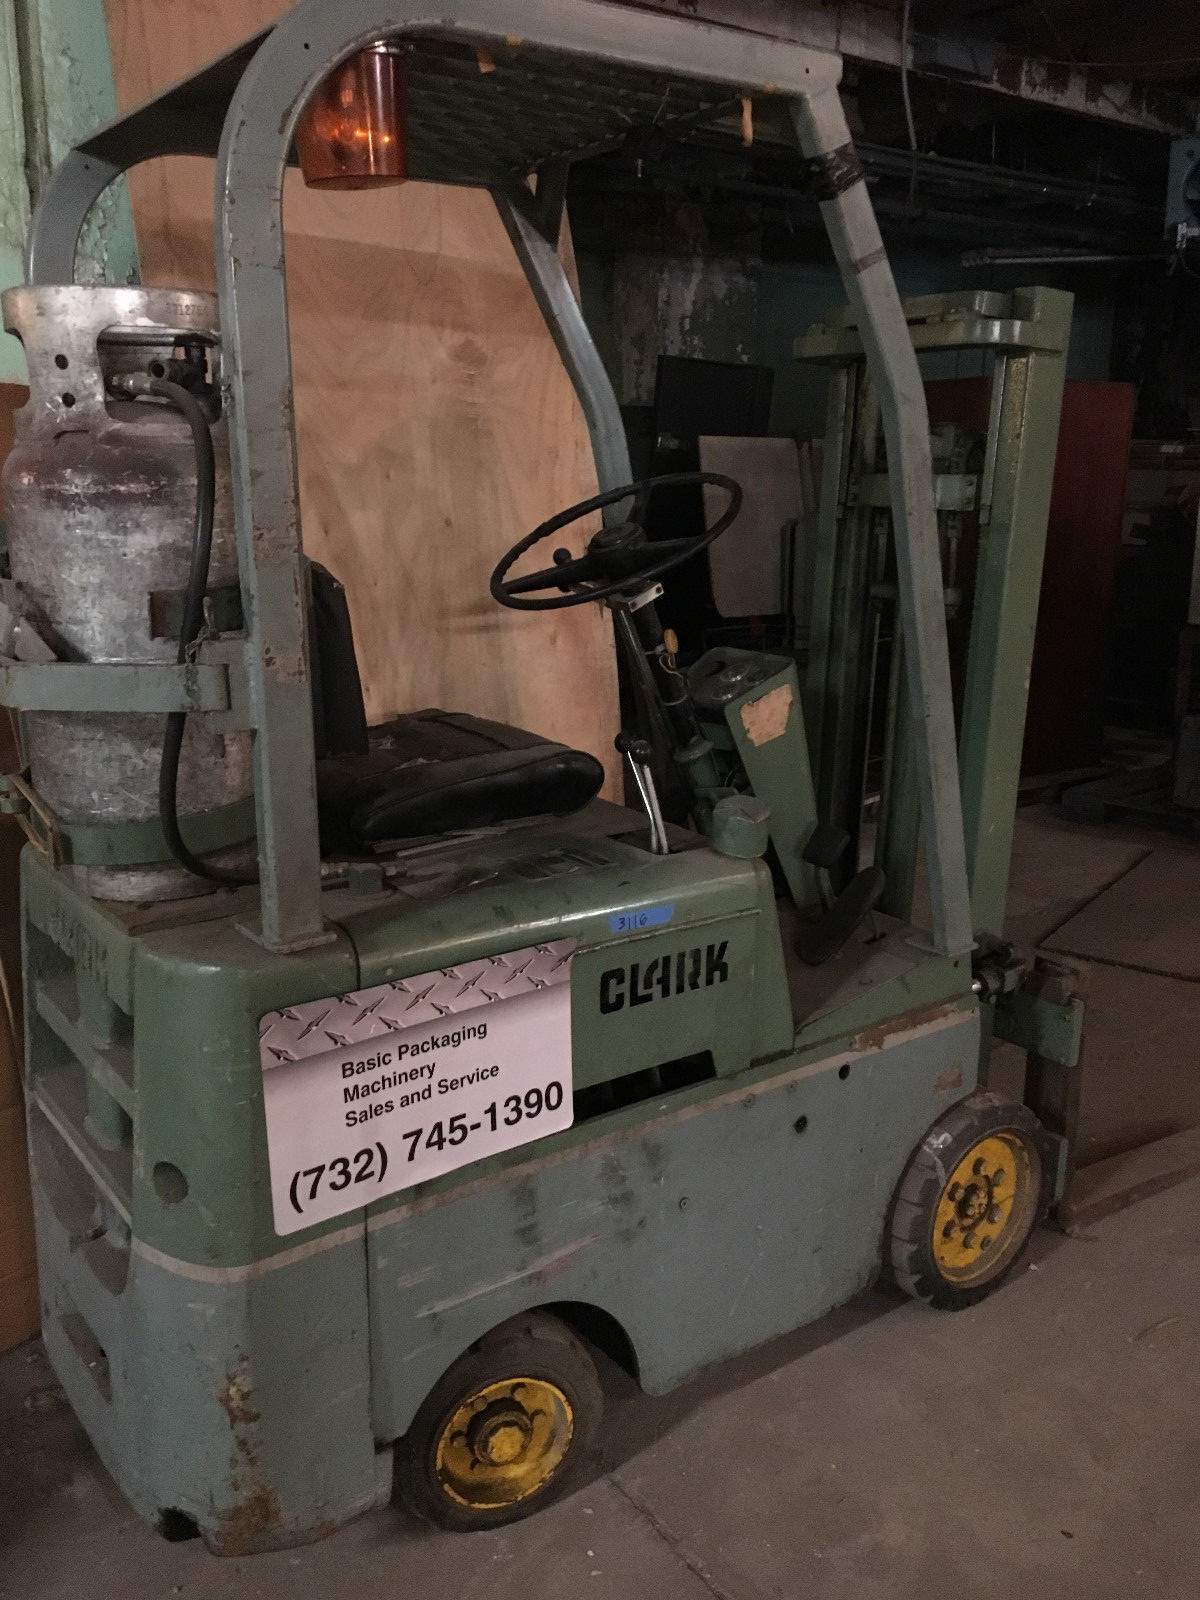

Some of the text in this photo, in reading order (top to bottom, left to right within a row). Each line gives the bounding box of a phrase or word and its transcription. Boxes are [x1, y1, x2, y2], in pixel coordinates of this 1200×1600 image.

[618, 913, 648, 930] 3116
[600, 941, 728, 1015] CLARK
[341, 1023, 487, 1079] Basic Packaging
[343, 1062, 436, 1103] Machinery
[345, 1065, 499, 1127] Sales and Service
[289, 1081, 563, 1214] (732) 745-1390
